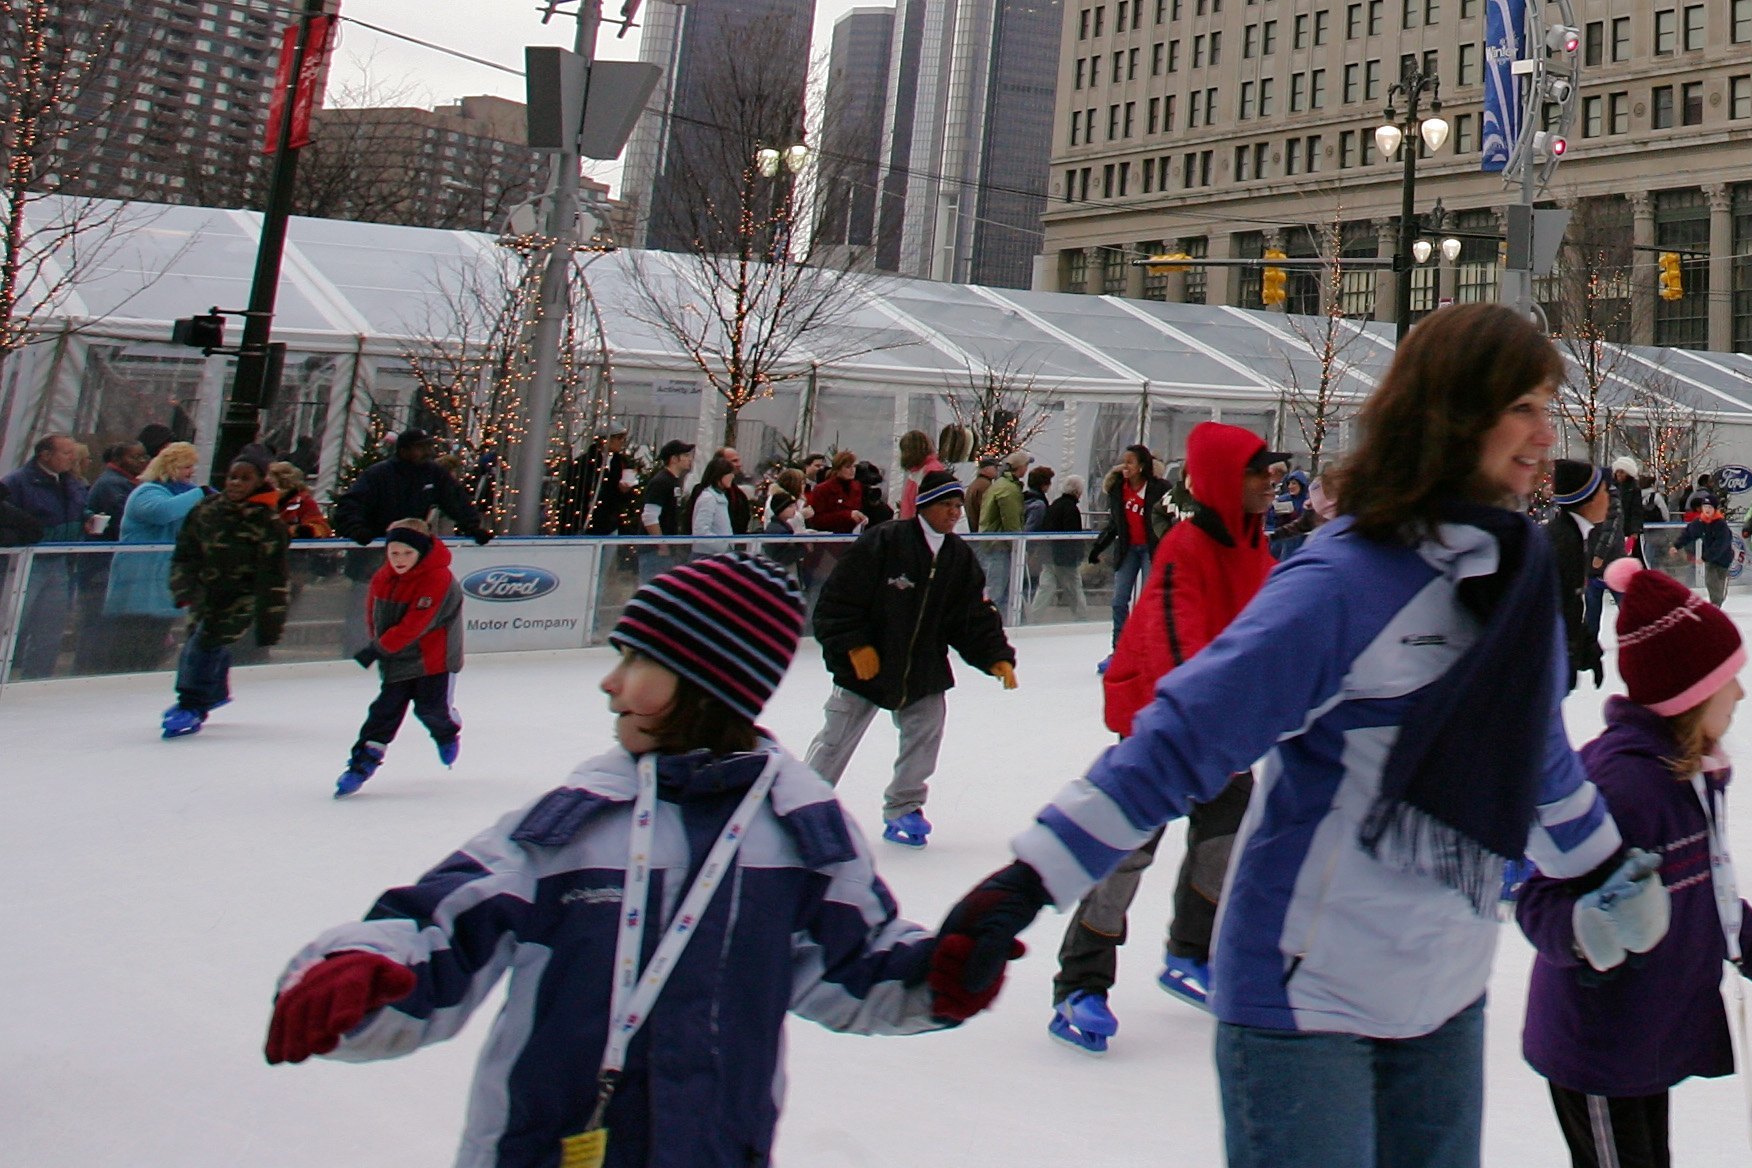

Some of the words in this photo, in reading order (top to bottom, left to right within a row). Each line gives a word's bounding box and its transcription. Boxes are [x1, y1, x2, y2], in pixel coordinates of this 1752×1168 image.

[1719, 468, 1748, 490] Ford
[479, 570, 541, 595] Ford
[467, 619, 508, 631] Motor
[512, 617, 577, 631] Company
